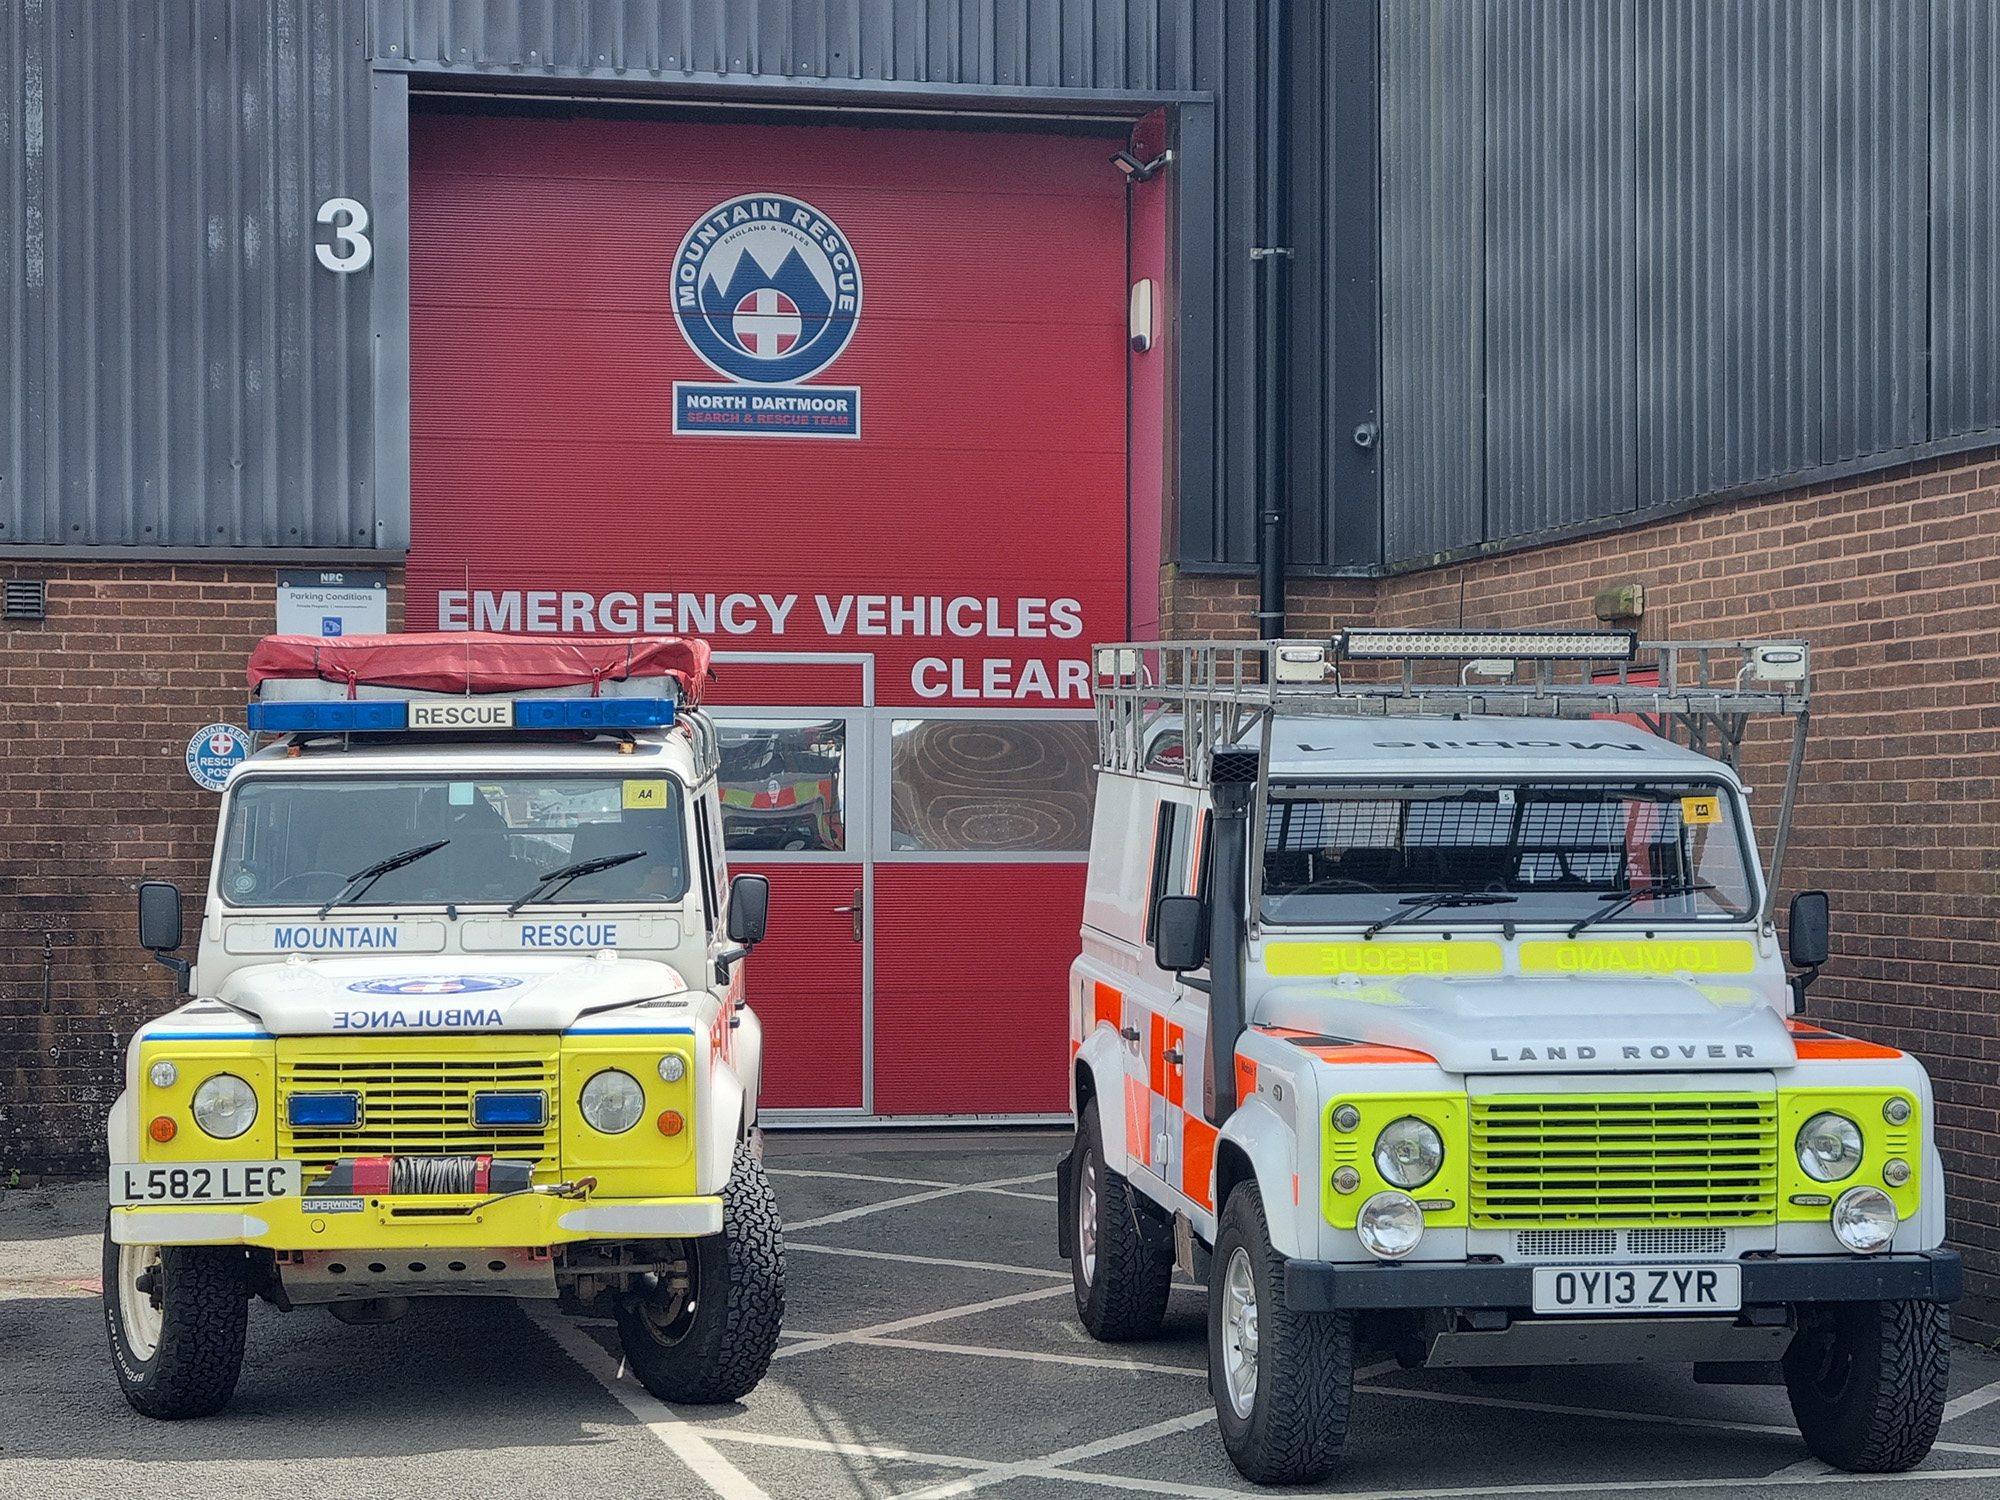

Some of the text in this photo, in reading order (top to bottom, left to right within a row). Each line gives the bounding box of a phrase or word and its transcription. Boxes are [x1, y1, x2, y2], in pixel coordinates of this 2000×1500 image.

[315, 197, 372, 272] 3
[724, 224, 767, 245] ENGLAND
[780, 227, 810, 247] WALES
[679, 201, 855, 311] MOUNTAIN RESCUE
[686, 394, 848, 412] NORTH DARTMOOR
[687, 412, 849, 426] SEARCH & RESCUE TEAM
[290, 592, 373, 603] Parking Conditions
[437, 590, 1084, 639] EMERGENCY VEHICLES
[910, 657, 1090, 701] CLEAR
[414, 706, 507, 726] RESCUE
[189, 726, 249, 754] MOUNTAIN RESC
[207, 768, 231, 777] POS
[638, 789, 653, 799] AA
[274, 924, 617, 948] MOUNTAIN RESCUE
[1491, 1043, 1756, 1062] LAND ROVER
[124, 1166, 287, 1201] L582 LEC
[302, 1200, 364, 1211] SUPERWINCH
[1555, 1270, 1718, 1305] OY13 ZYR
